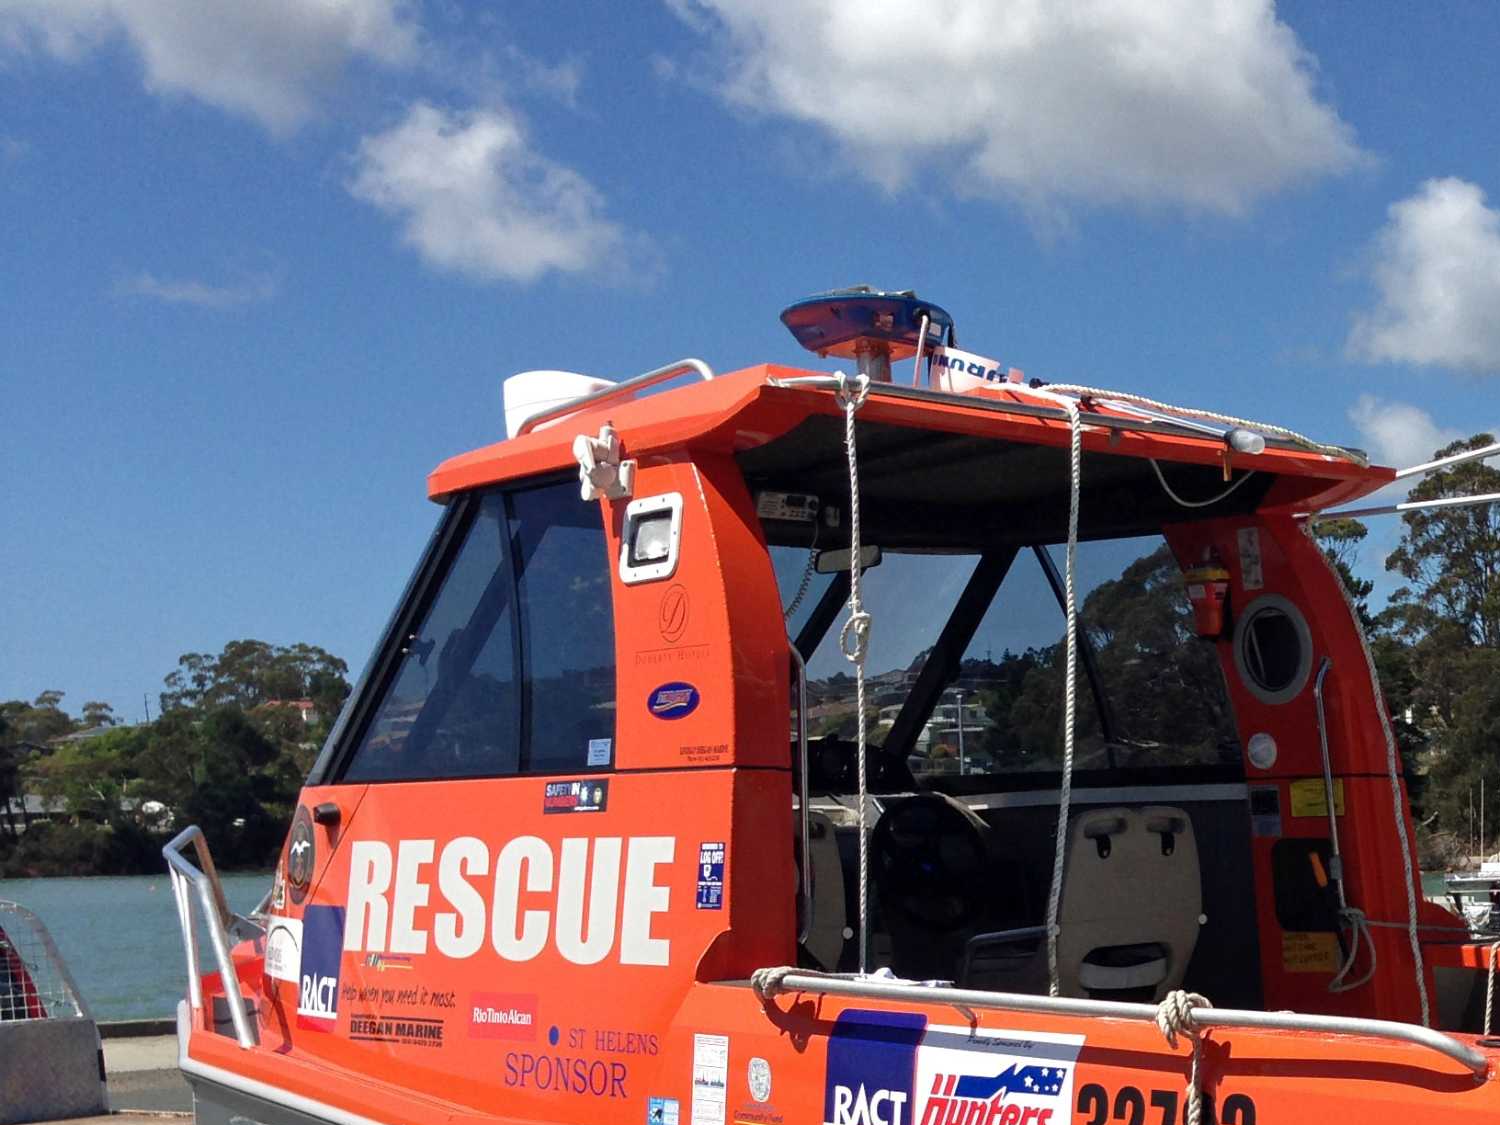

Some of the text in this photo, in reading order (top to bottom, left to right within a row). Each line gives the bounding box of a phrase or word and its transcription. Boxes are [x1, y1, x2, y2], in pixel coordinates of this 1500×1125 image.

[344, 835, 676, 966] RESCUE
[301, 972, 337, 1014] RACT
[351, 1020, 443, 1040] DEEGAN MARINE
[569, 1028, 658, 1056] ST HELENS
[505, 1052, 627, 1098] SPONSOR
